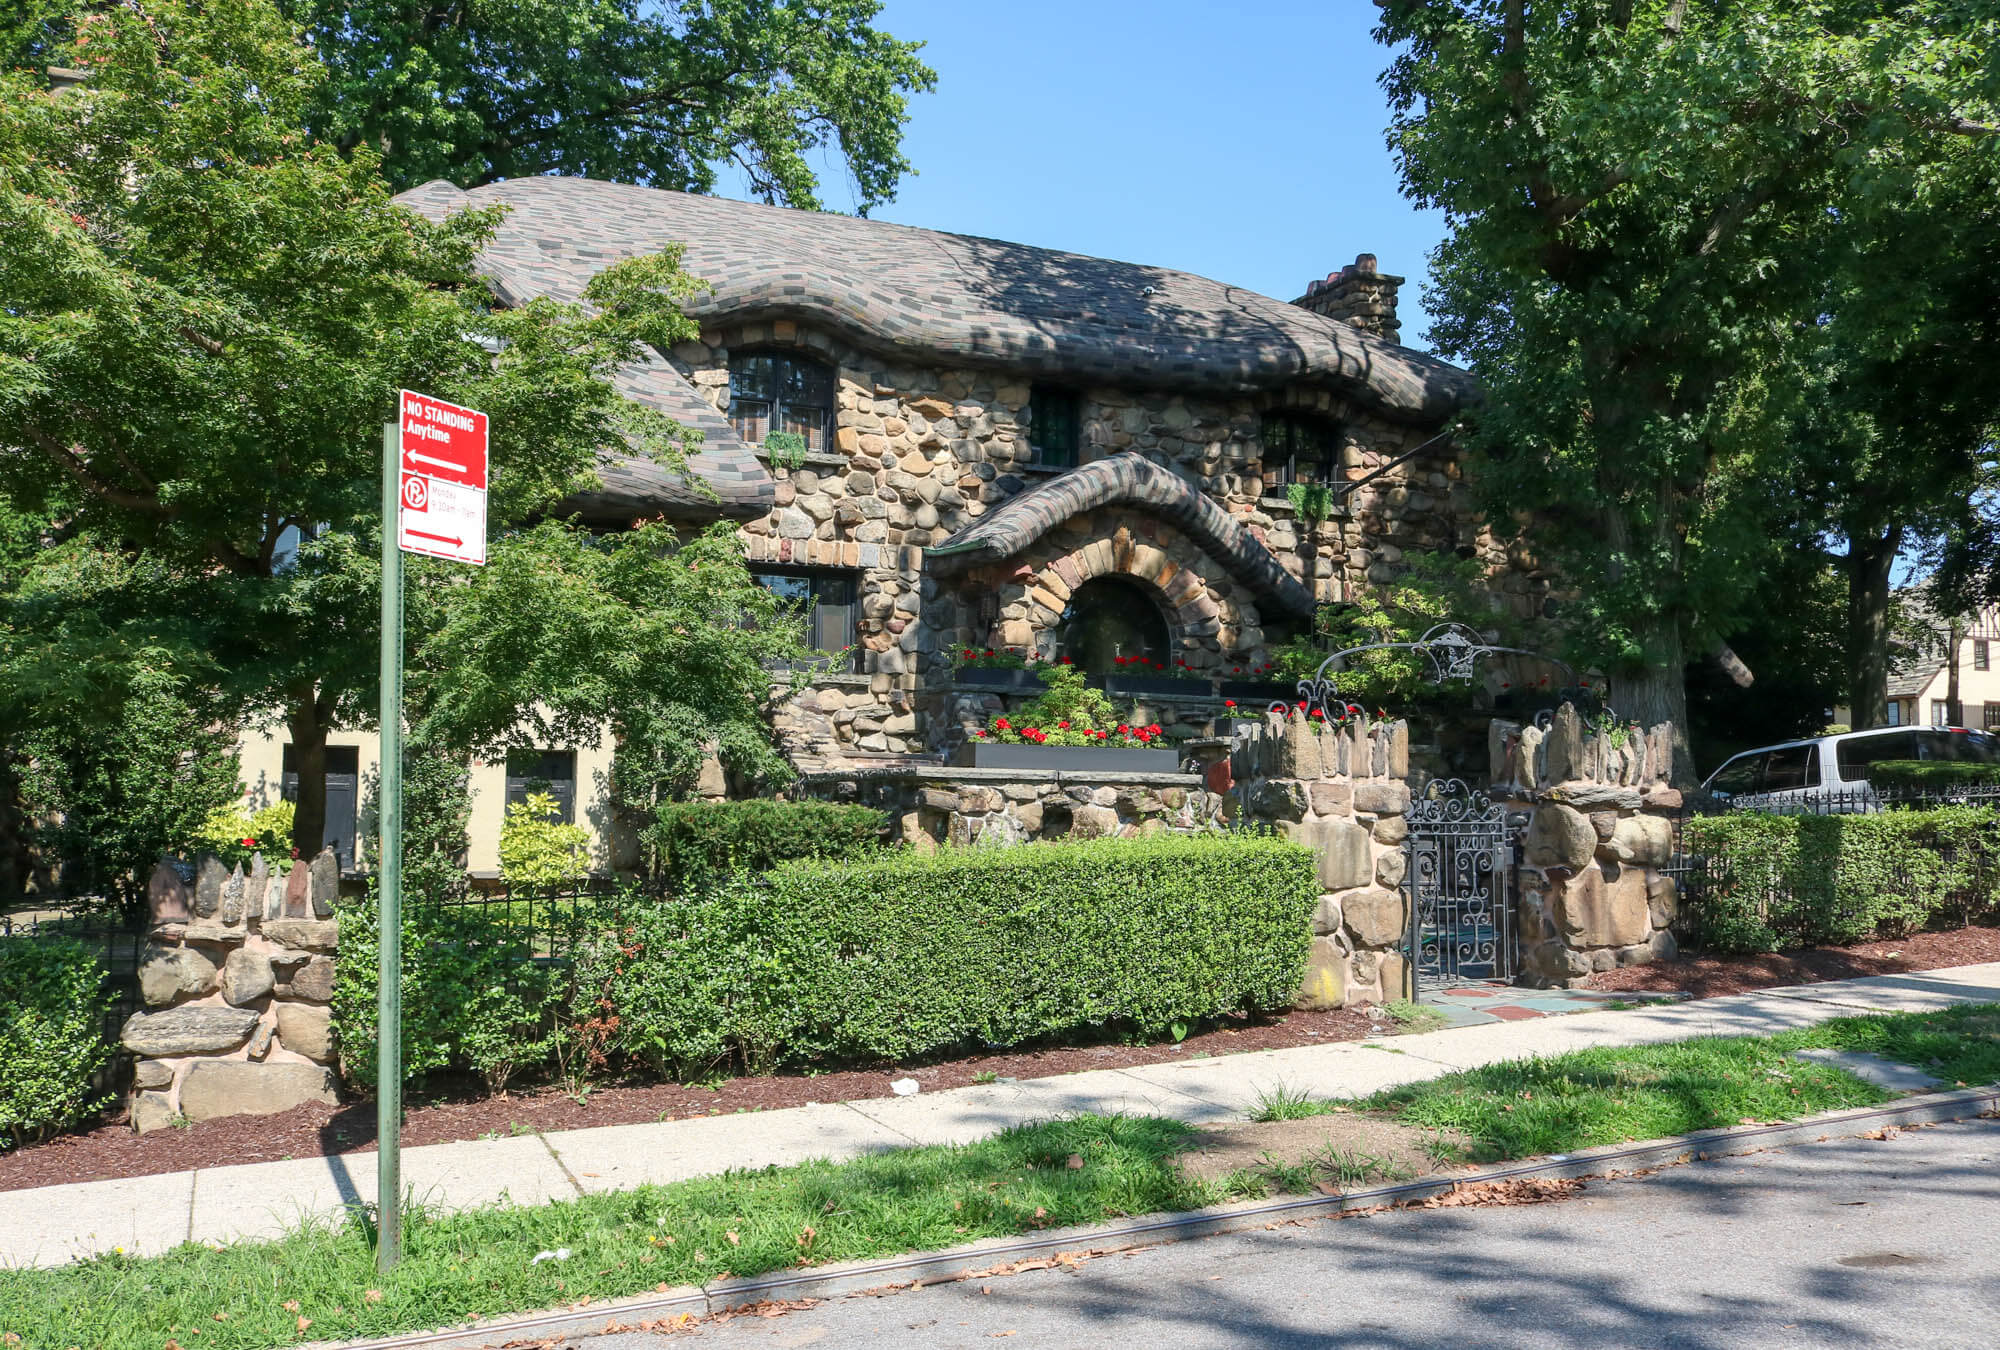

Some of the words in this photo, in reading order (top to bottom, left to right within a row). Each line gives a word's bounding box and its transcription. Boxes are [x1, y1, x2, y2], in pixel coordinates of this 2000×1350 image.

[407, 400, 422, 416] NO
[424, 405, 474, 431] STANDING
[407, 419, 450, 443] Anytime
